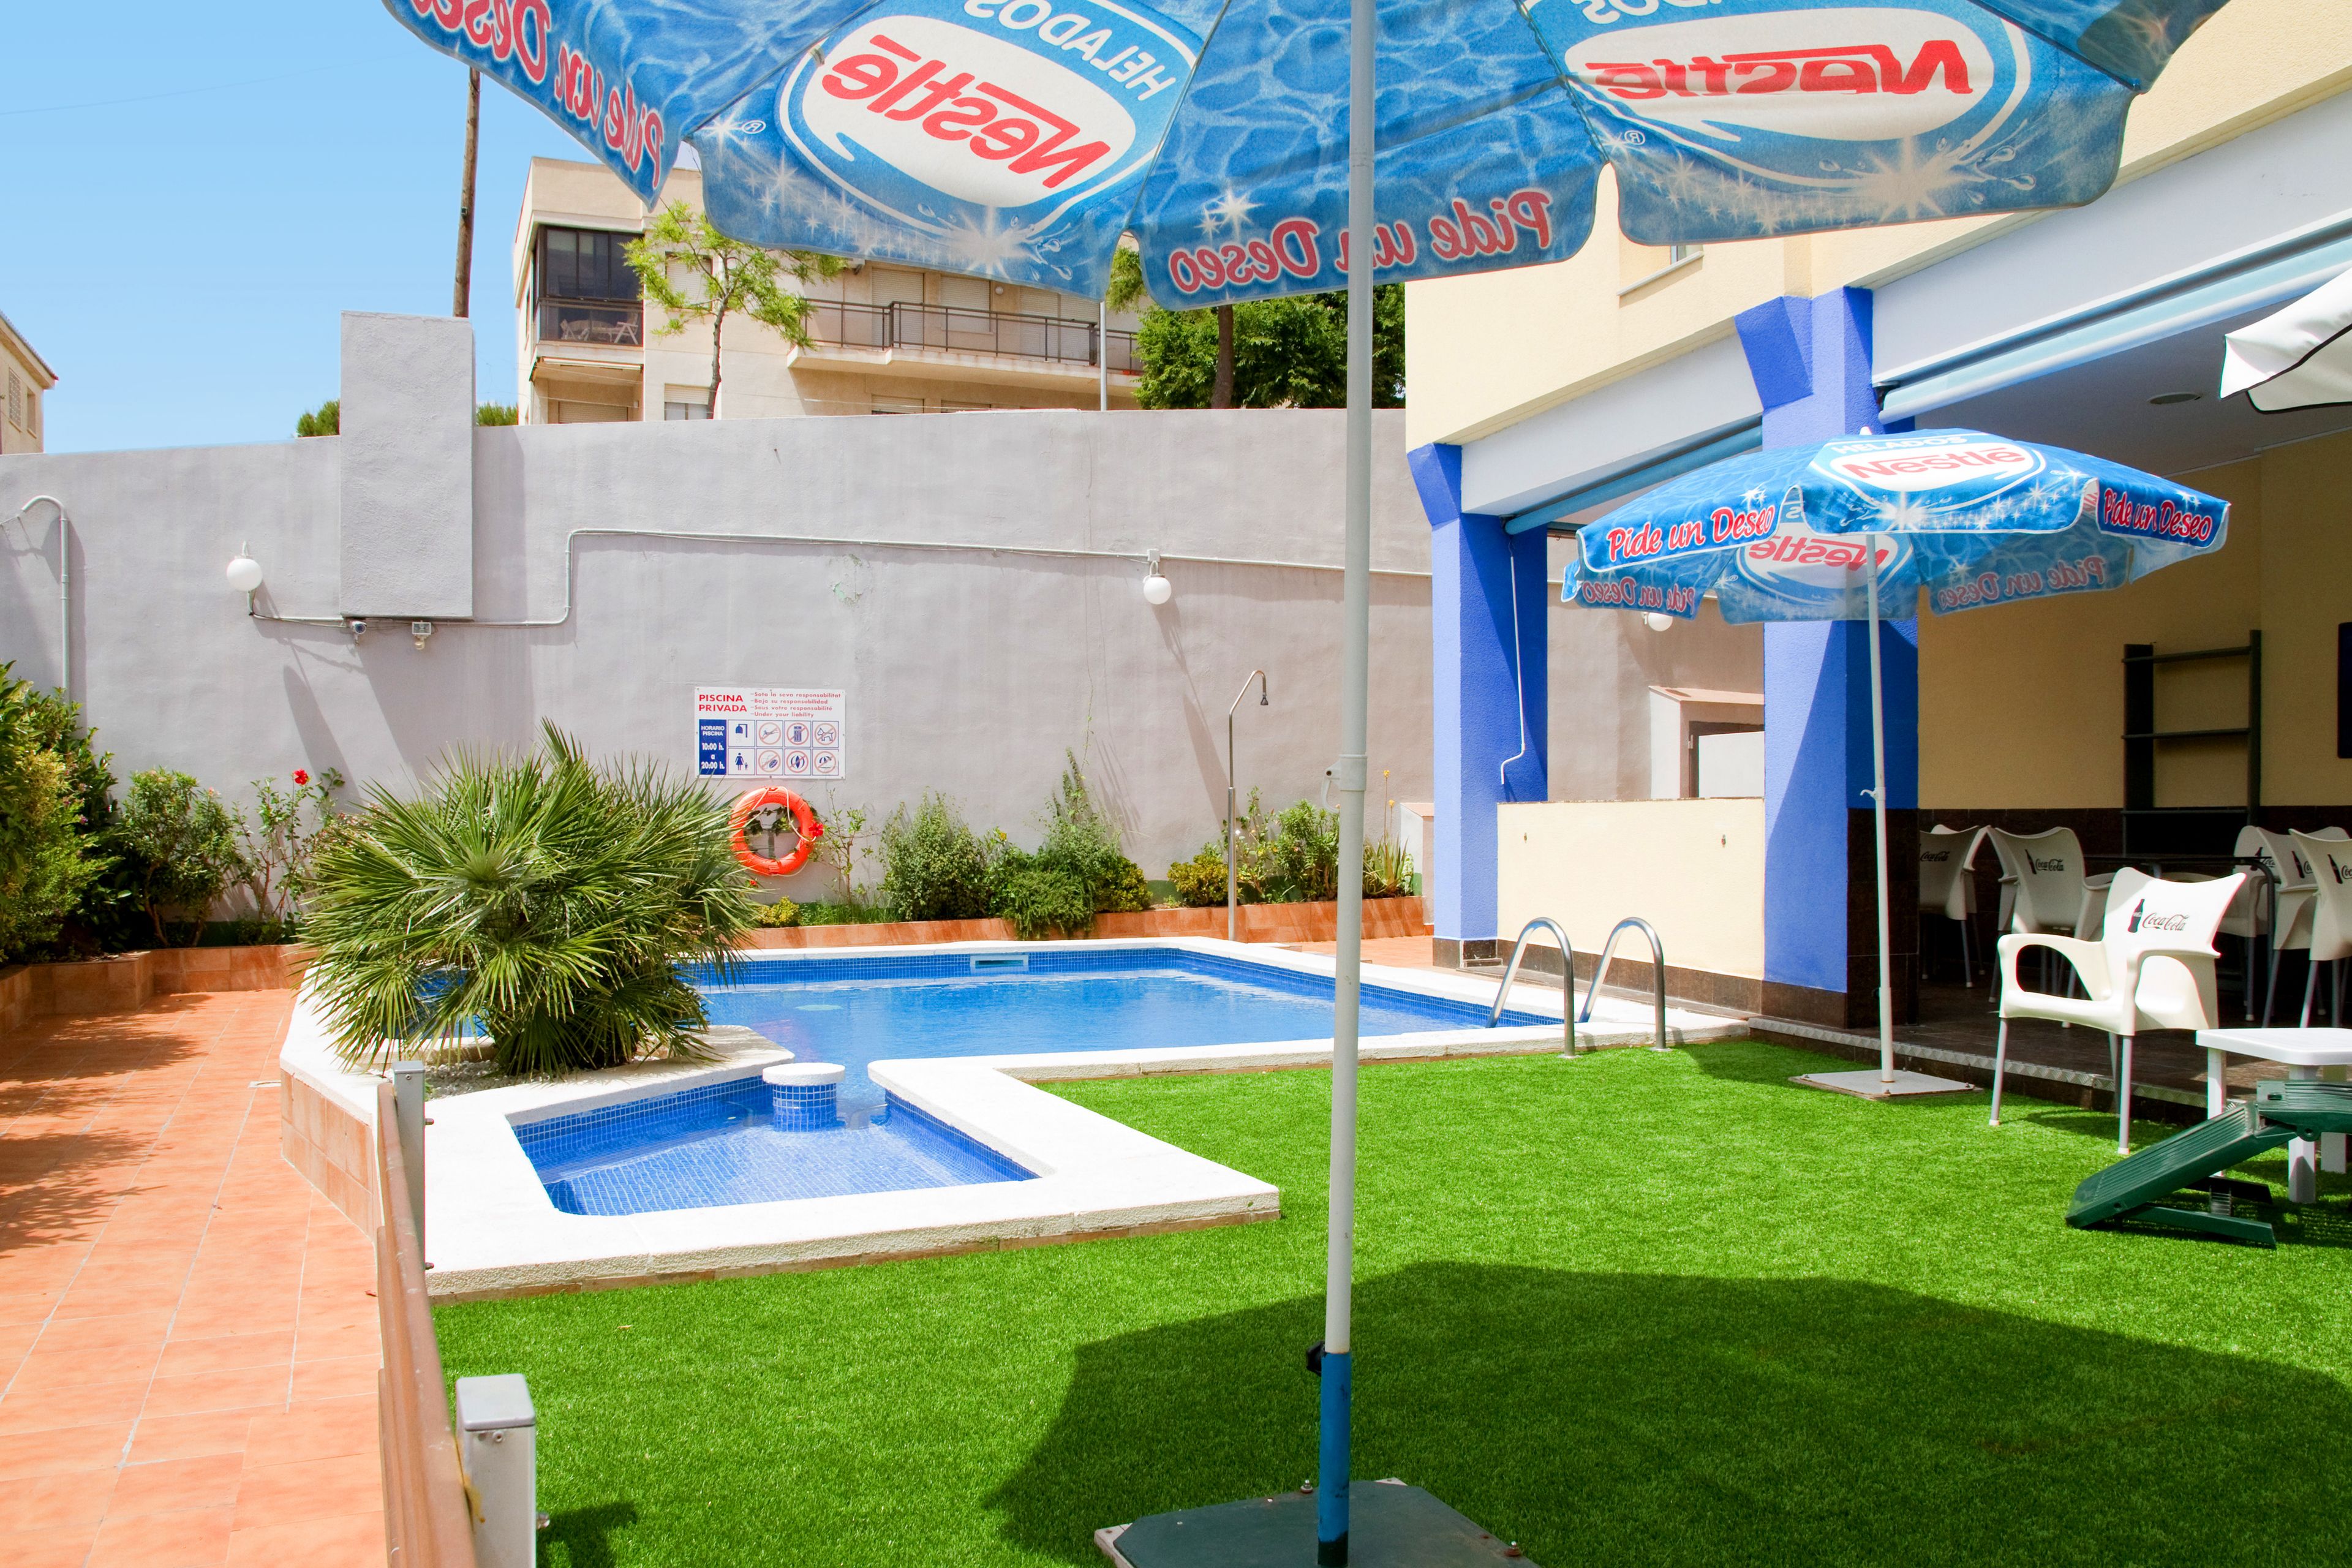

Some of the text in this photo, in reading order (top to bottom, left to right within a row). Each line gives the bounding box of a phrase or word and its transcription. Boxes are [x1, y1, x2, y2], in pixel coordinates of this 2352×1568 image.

[1831, 435, 1968, 454] HELADOS
[1607, 505, 1775, 562] Pide un Deseo
[2104, 488, 2132, 527] Pide
[2133, 503, 2157, 531] un
[2160, 500, 2212, 542] Deseo
